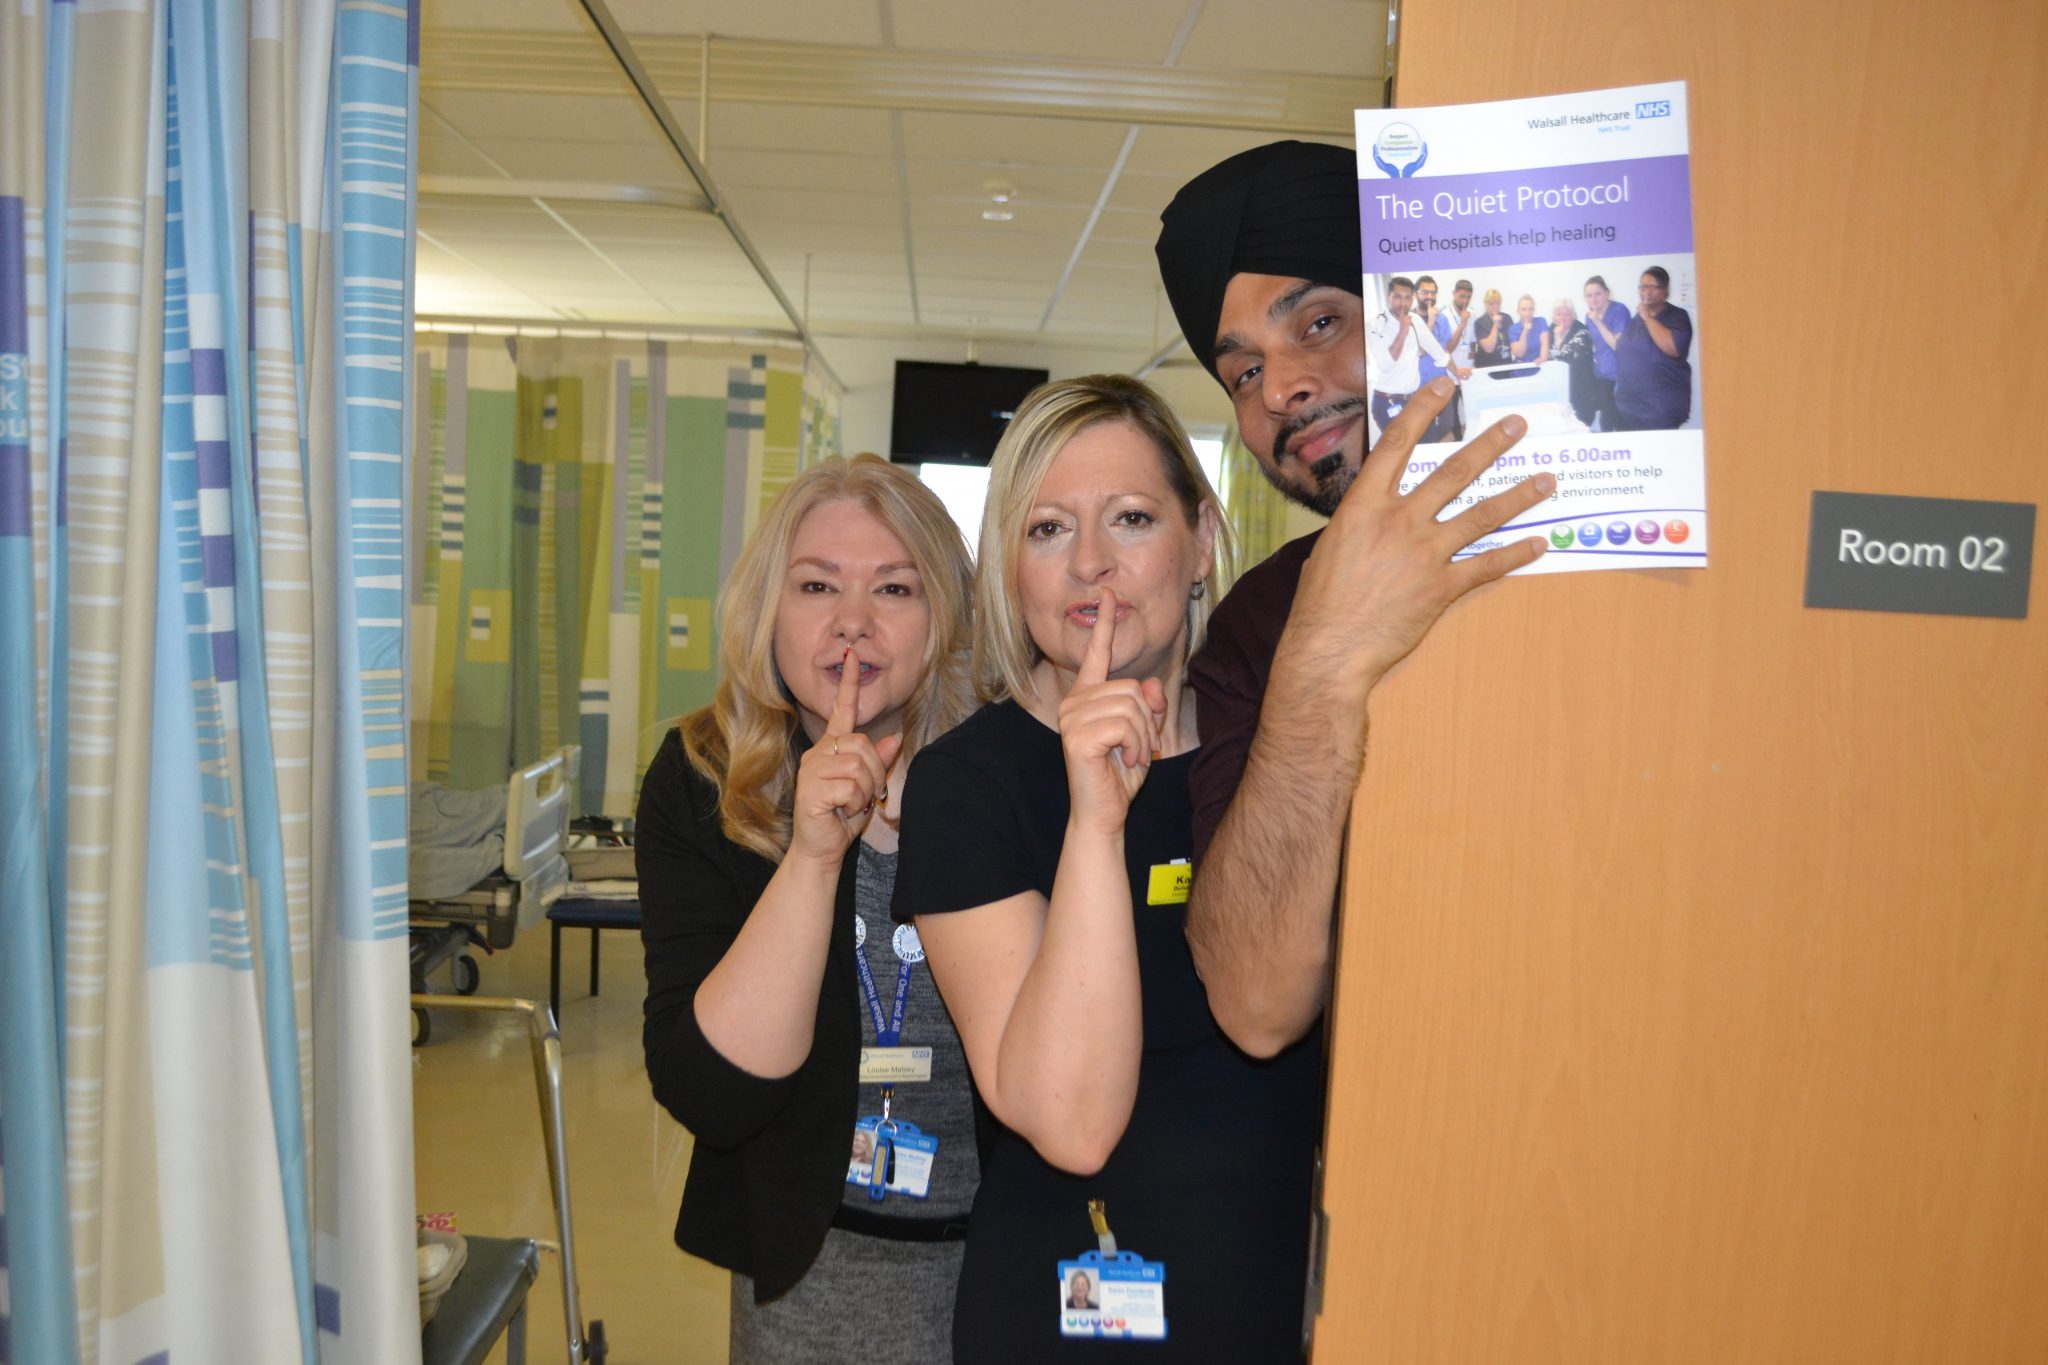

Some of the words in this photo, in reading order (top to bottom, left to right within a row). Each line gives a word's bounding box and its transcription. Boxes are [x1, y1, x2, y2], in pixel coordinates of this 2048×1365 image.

[1528, 116, 1567, 129] Walsall
[1570, 111, 1630, 125] Healthcare
[1636, 101, 1670, 119] NHS
[1376, 194, 1423, 220] The
[1432, 189, 1508, 221] Quiet
[1517, 175, 1630, 211] Protocol
[1378, 238, 1424, 256] Quiet
[1429, 231, 1504, 252] hospitals
[1508, 227, 1546, 247] help
[1551, 222, 1616, 243] healing
[1532, 451, 1552, 465] to
[1559, 447, 1631, 464] 6.00am
[1569, 468, 1613, 481] visitors
[1617, 469, 1630, 478] to
[1634, 466, 1663, 478] help
[1562, 484, 1644, 499] environment
[1838, 528, 1948, 569] Room
[1959, 535, 2006, 573] 02
[856, 948, 877, 999] Healthcare
[897, 978, 908, 998] One
[870, 1000, 886, 1033] Walsall
[894, 999, 903, 1018] and
